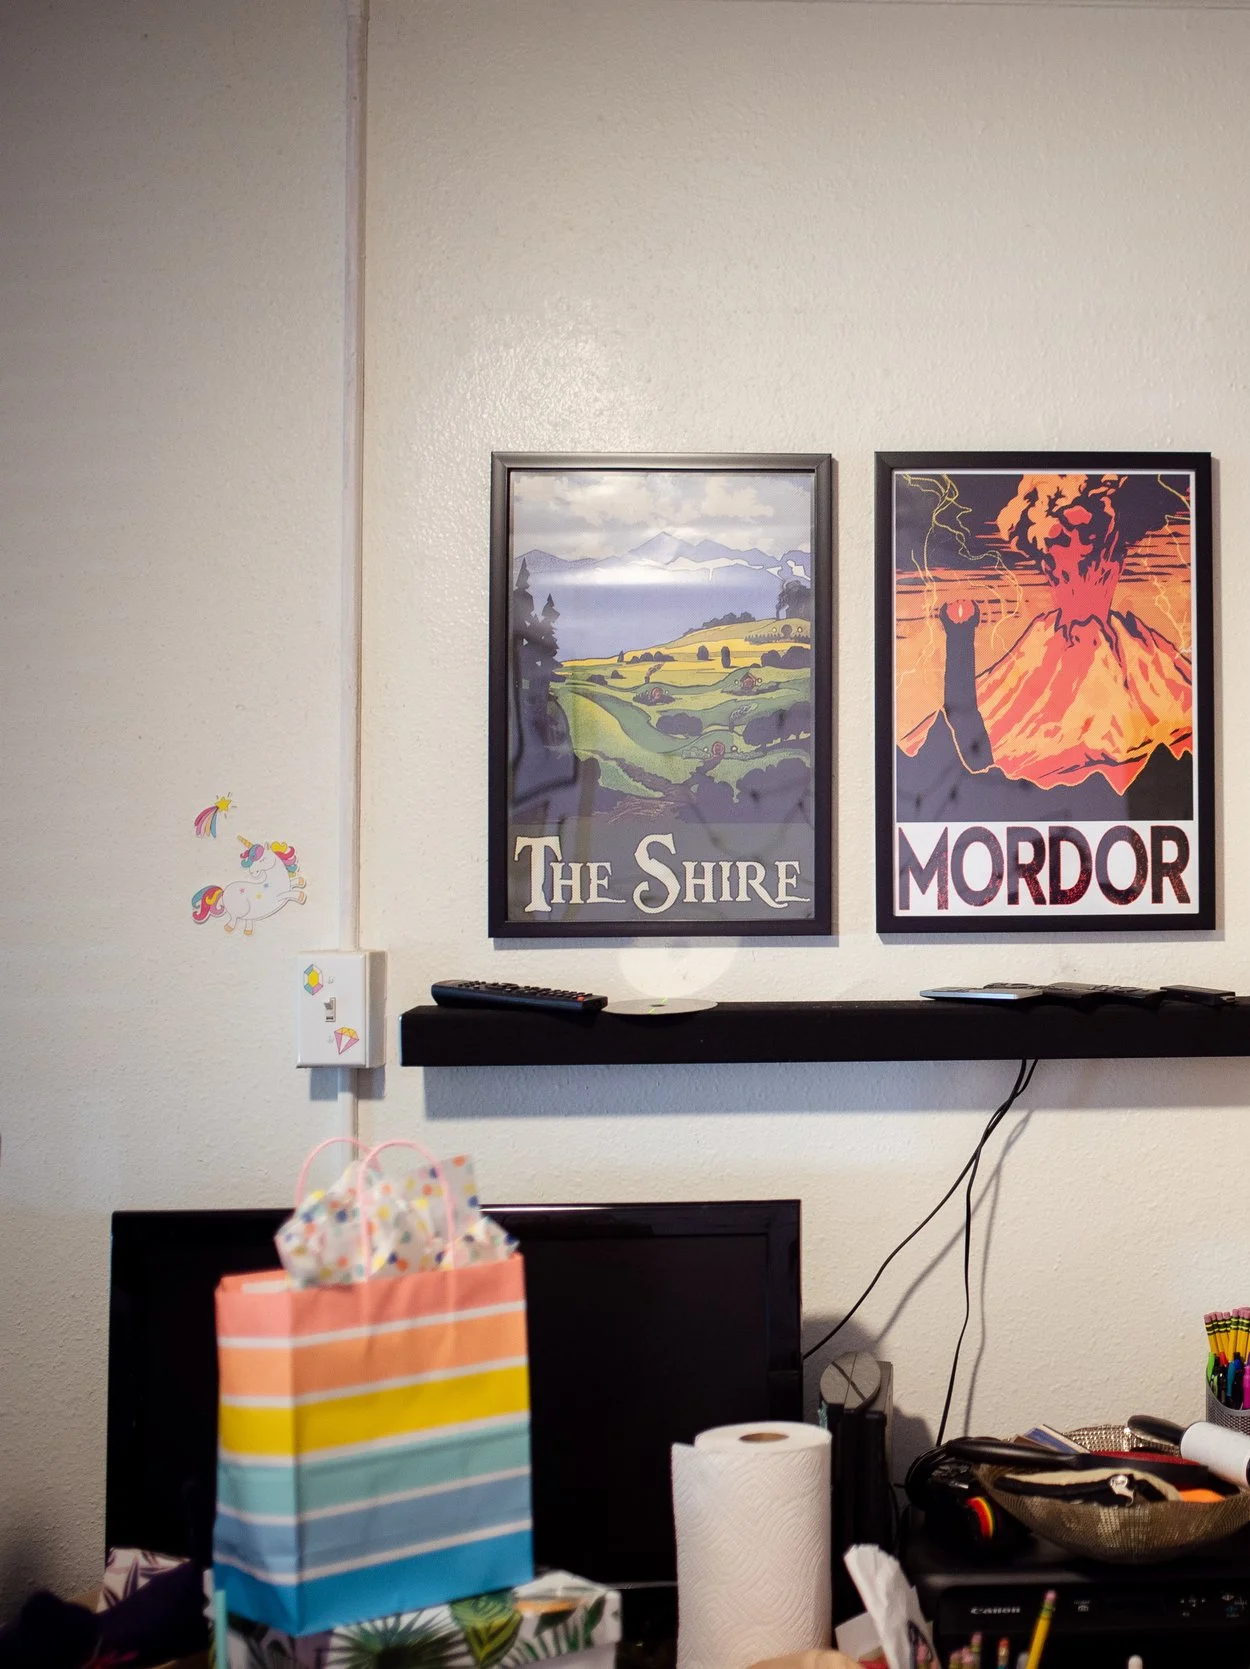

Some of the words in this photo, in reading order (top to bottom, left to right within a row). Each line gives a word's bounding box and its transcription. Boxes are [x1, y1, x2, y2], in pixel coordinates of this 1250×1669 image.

[513, 836, 626, 913] THE
[632, 833, 811, 914] SHIRE
[897, 824, 1191, 911] MORDOR
[970, 1606, 1021, 1614] Canon
